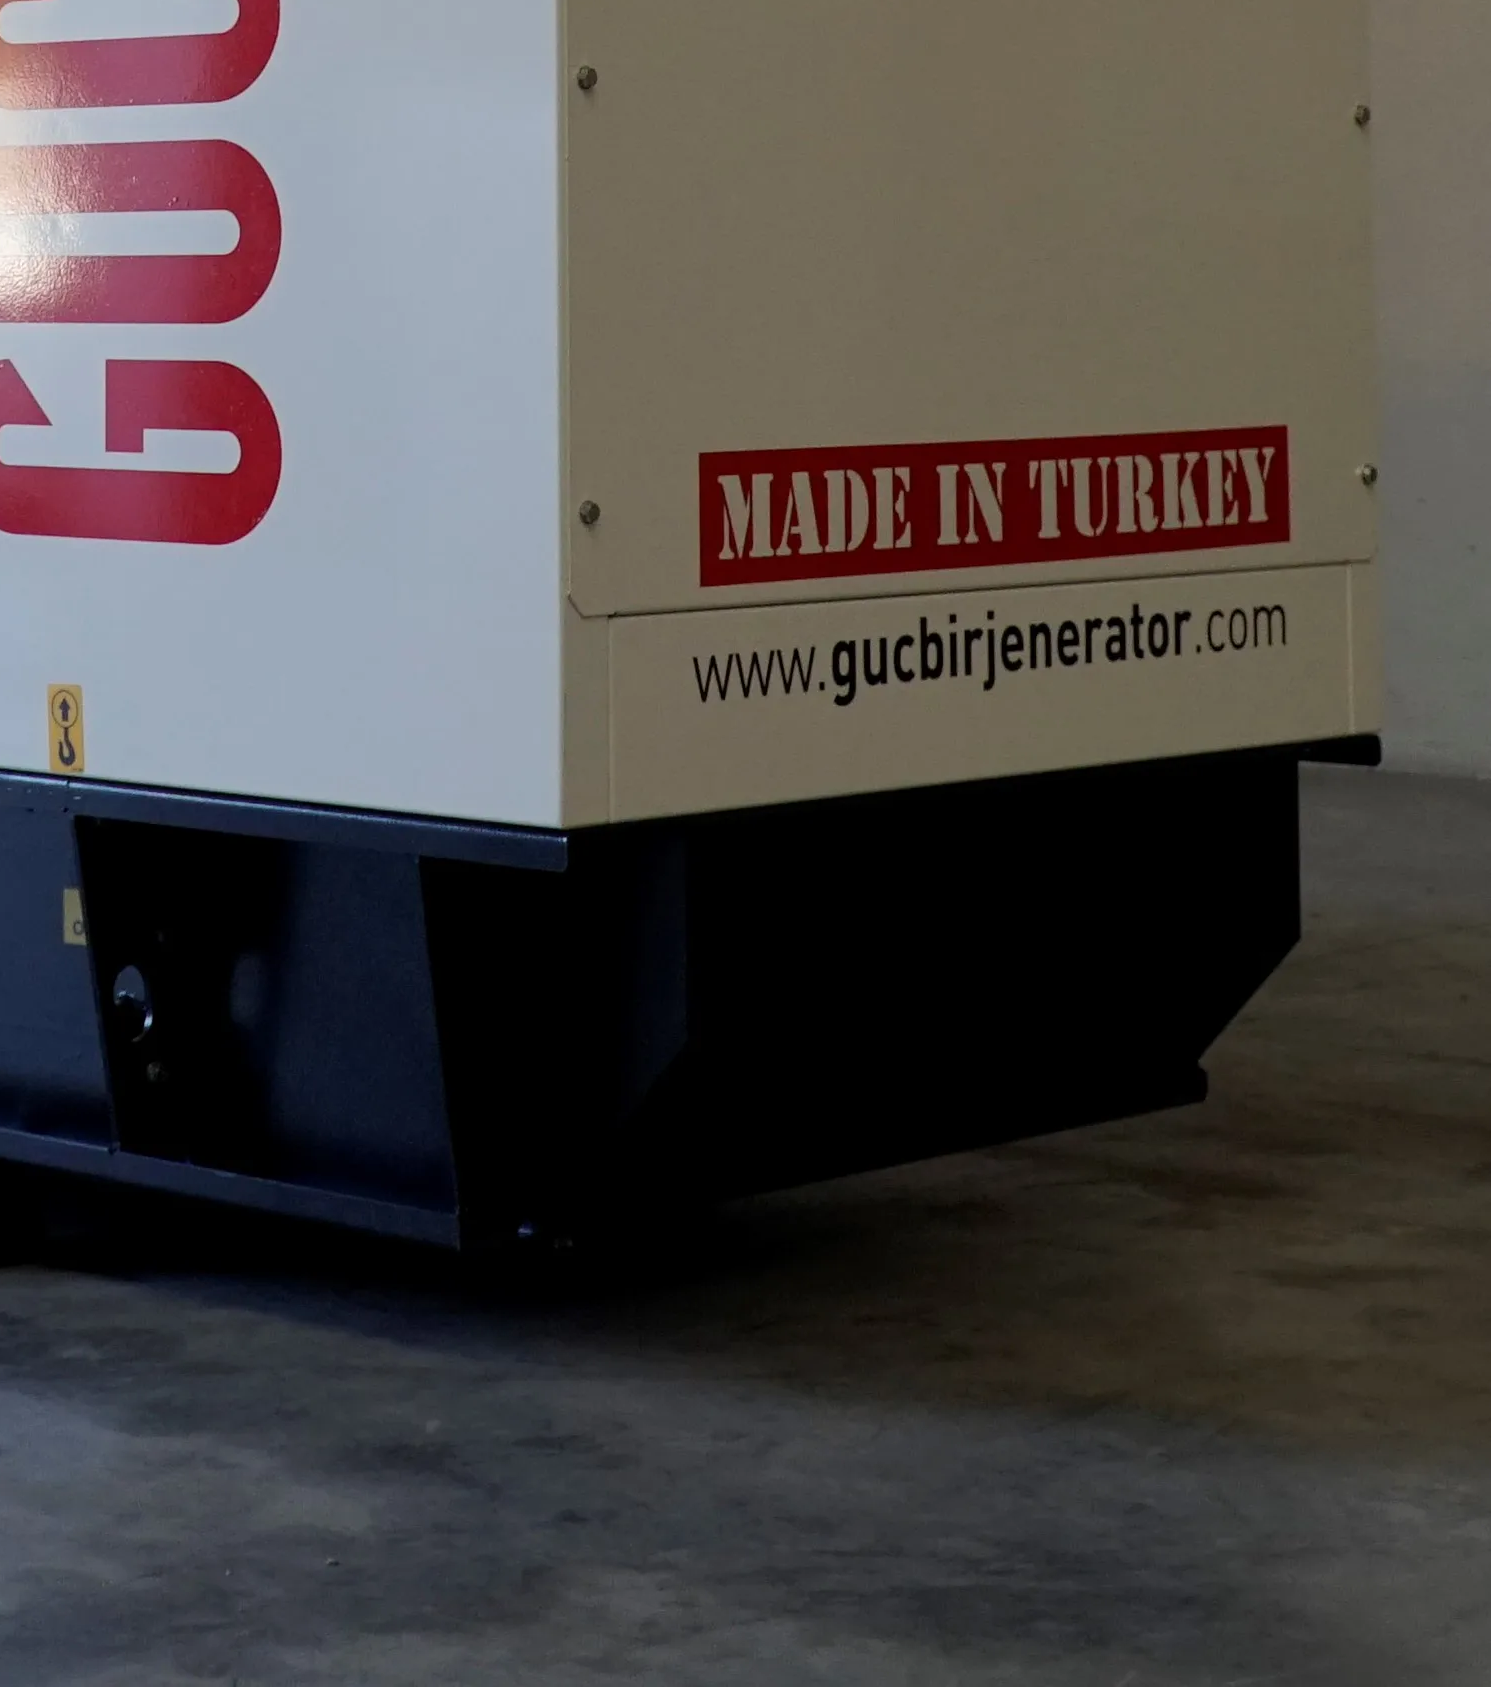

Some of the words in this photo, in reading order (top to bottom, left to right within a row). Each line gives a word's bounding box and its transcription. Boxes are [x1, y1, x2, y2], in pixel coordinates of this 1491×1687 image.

[717, 465, 912, 561] MADE
[936, 461, 1007, 547] IN
[1028, 446, 1276, 540] TURKEY
[692, 603, 1287, 707] www.gucbirjenerator.com
